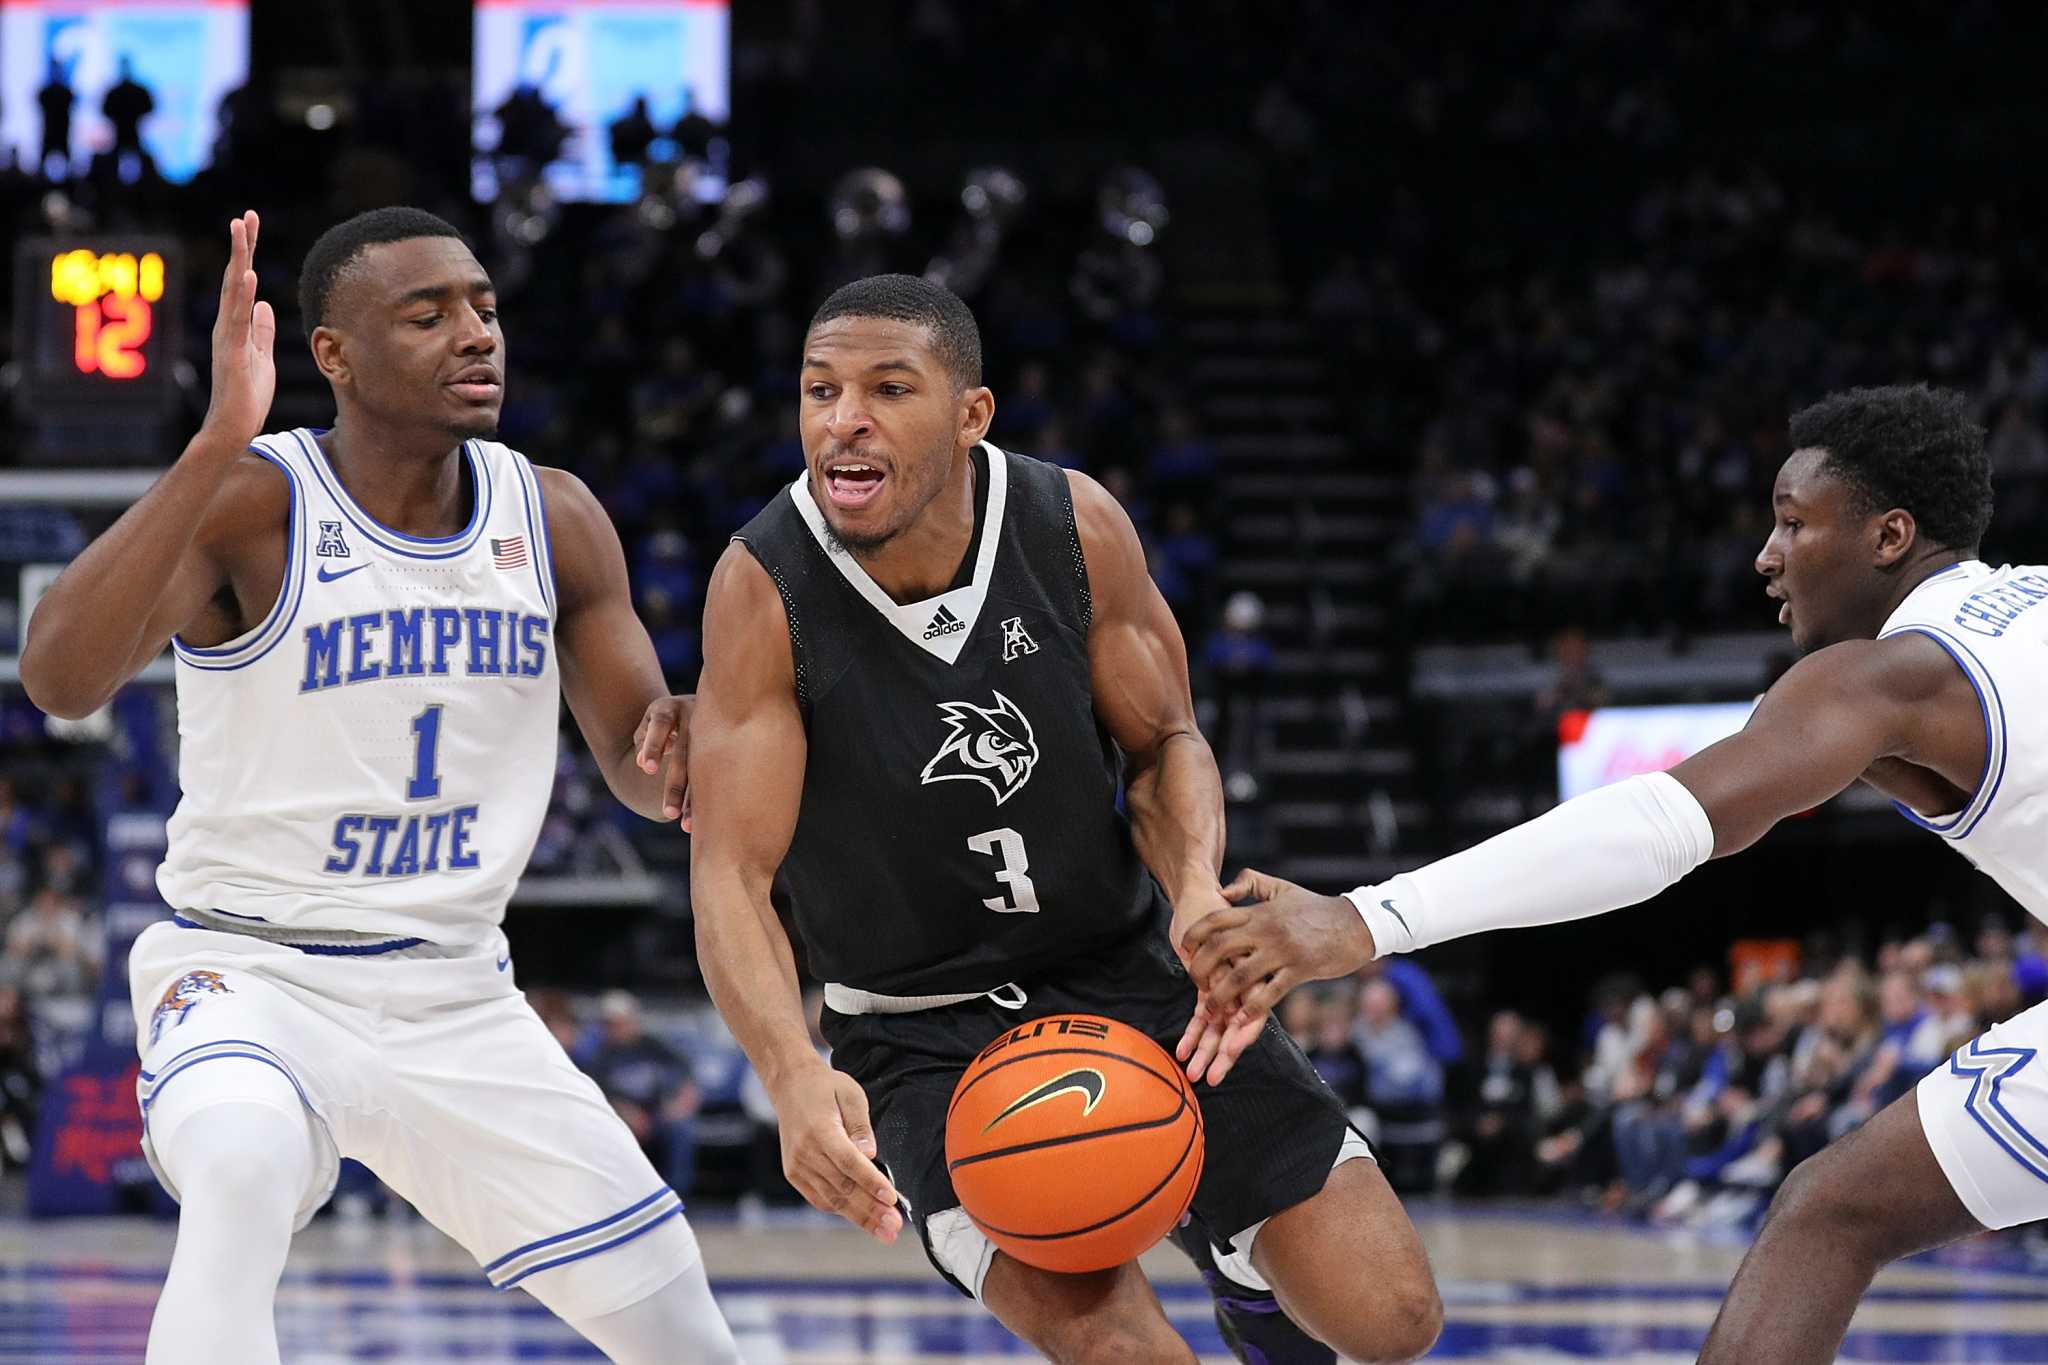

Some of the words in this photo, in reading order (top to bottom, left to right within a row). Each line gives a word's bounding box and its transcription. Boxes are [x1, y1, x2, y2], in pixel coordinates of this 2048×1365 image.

[75, 294, 151, 377] 12
[316, 520, 350, 558] A
[298, 606, 550, 695] MEMPHIS
[923, 620, 966, 640] adidas
[1001, 616, 1040, 662] A
[404, 703, 444, 802] 1
[324, 804, 481, 877] STATE
[967, 827, 1040, 913] 3
[978, 1019, 1109, 1064] ELITE
